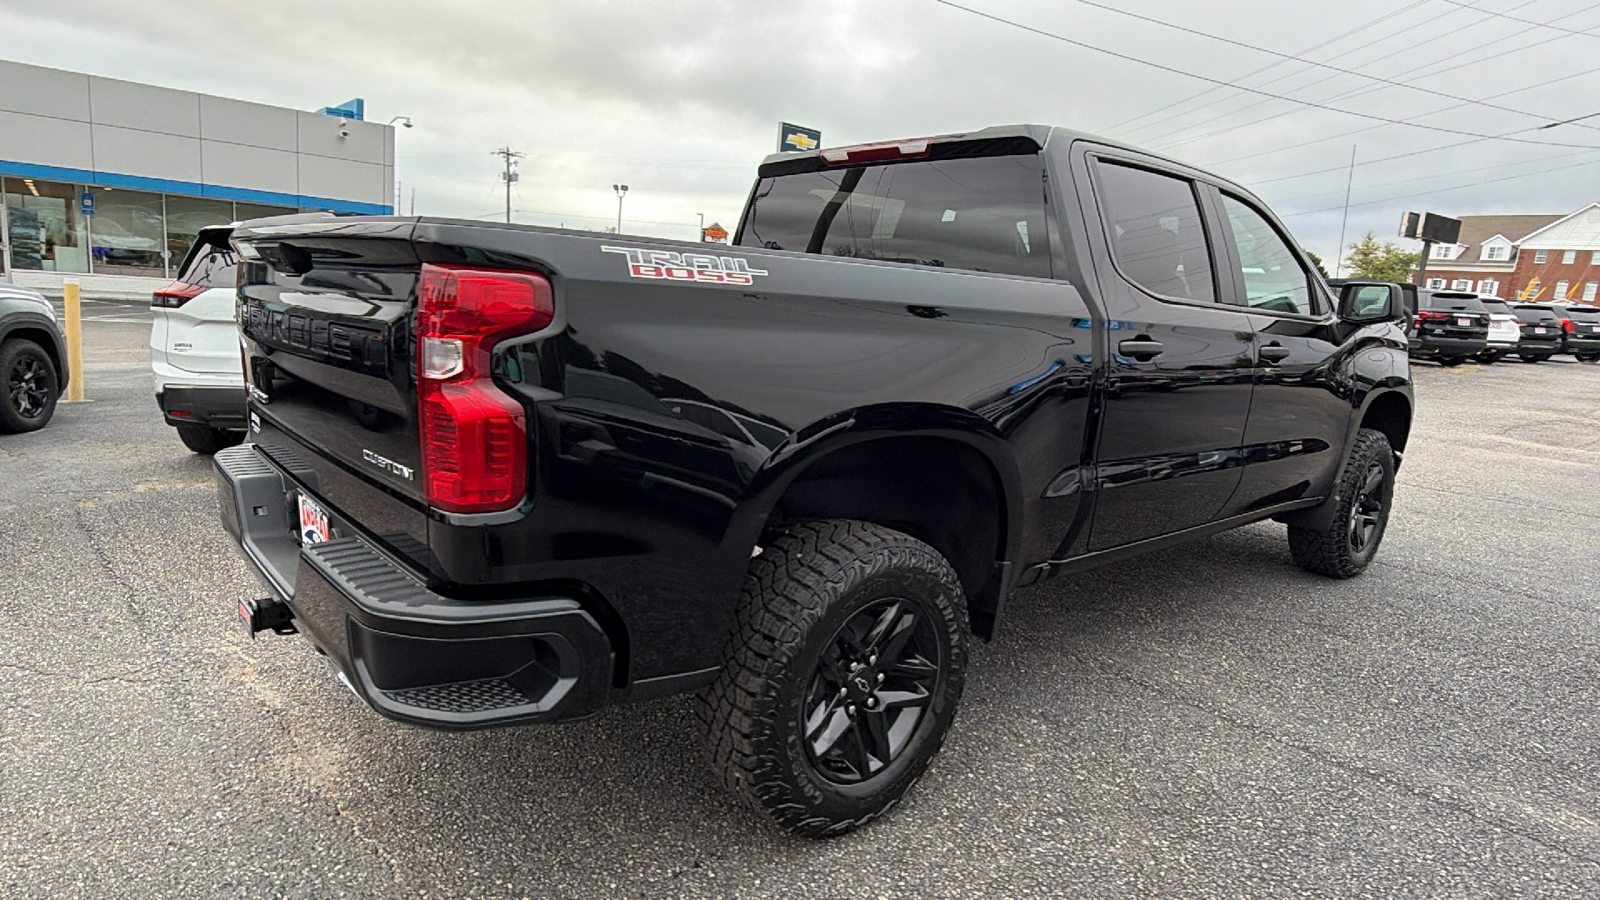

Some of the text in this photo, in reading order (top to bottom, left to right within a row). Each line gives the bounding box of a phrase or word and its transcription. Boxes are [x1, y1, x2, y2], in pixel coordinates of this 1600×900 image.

[601, 245, 769, 276] TRAIL
[630, 264, 754, 285] BOSS
[362, 448, 414, 481] CUSTOM
